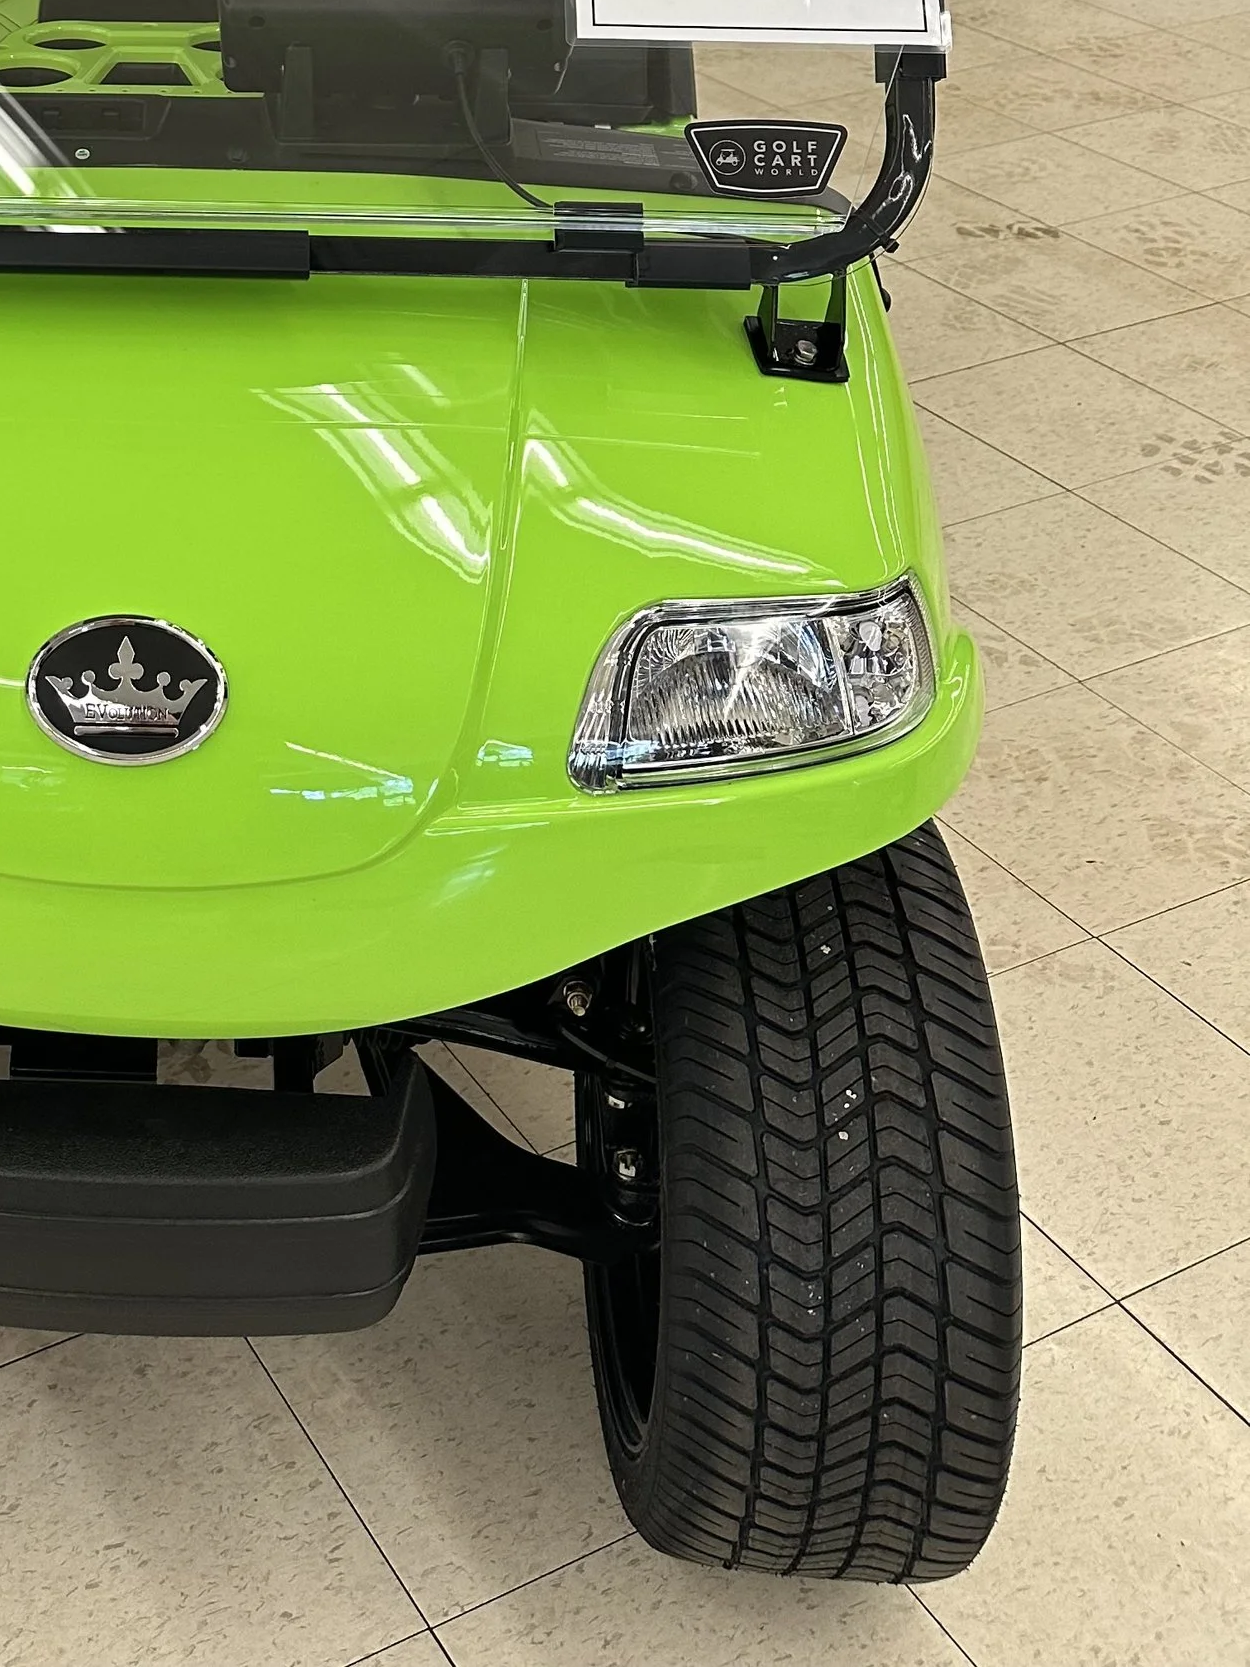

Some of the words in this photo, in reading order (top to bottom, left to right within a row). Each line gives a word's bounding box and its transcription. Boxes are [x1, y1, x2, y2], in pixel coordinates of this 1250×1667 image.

[753, 140, 818, 153] GOLF
[753, 154, 818, 167] CART
[754, 168, 818, 176] WORLD
